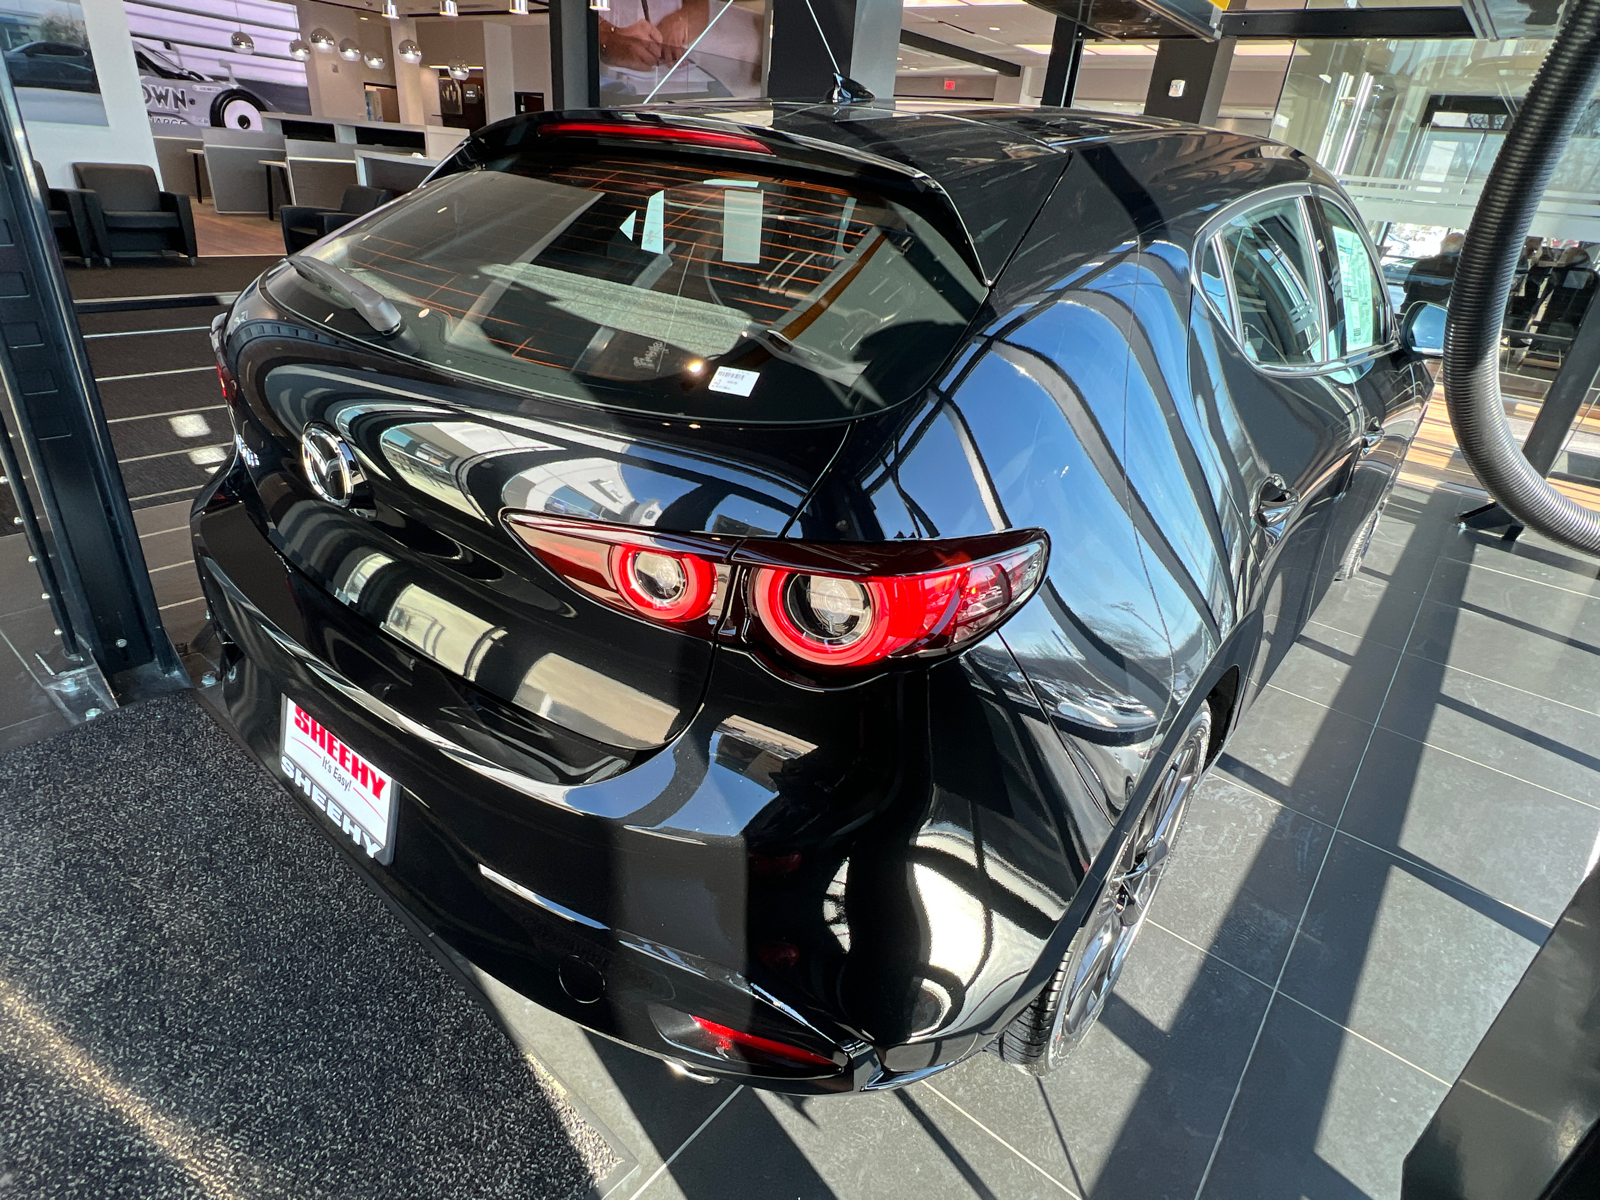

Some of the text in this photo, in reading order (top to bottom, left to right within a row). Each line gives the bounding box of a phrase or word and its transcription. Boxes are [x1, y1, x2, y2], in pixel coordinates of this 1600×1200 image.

[294, 704, 386, 800] SHEEHY
[322, 756, 351, 792] It's Easy!
[281, 756, 381, 858] SHEEHY
